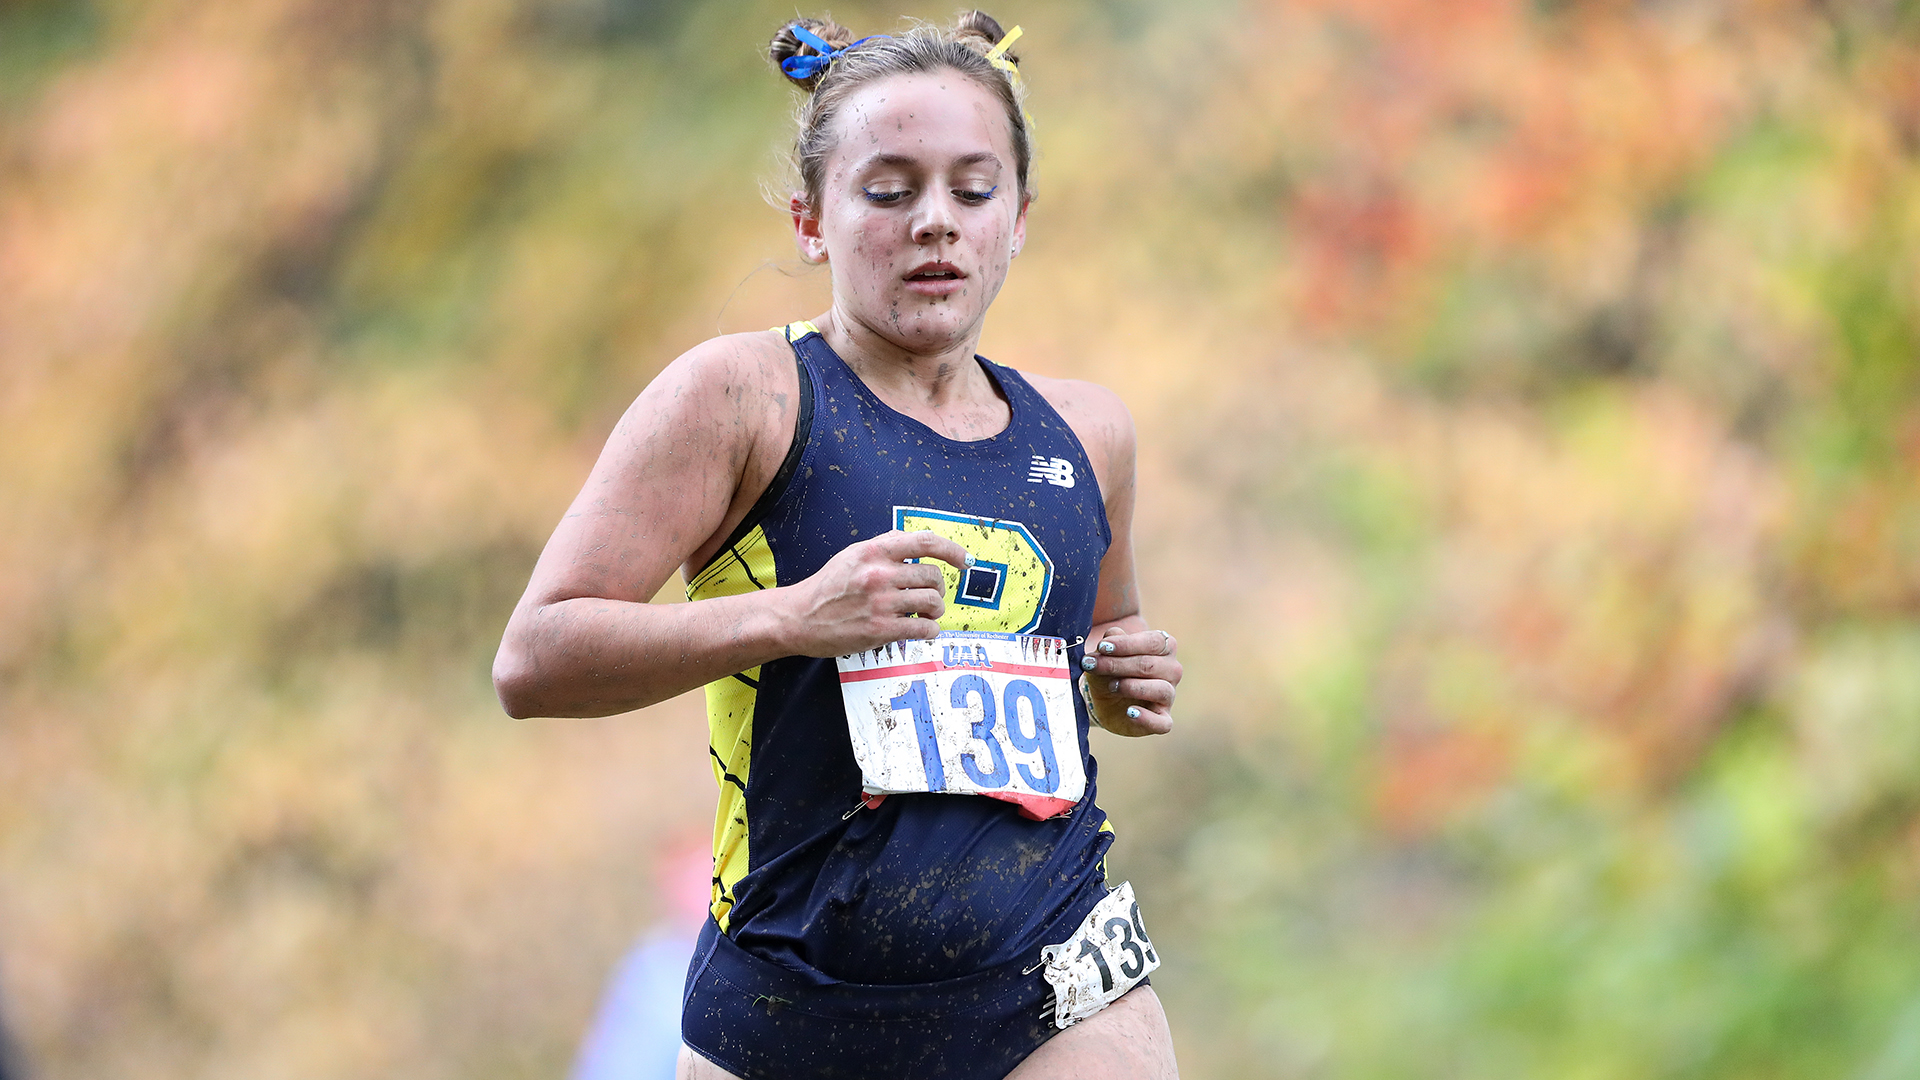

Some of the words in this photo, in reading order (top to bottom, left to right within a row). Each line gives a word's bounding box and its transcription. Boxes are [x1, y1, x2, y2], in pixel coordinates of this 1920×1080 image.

[1027, 455, 1076, 489] NB
[956, 632, 980, 640] University
[980, 632, 986, 640] of
[986, 633, 1009, 641] Rochester
[942, 645, 992, 668] UAA
[890, 674, 1060, 794] 139
